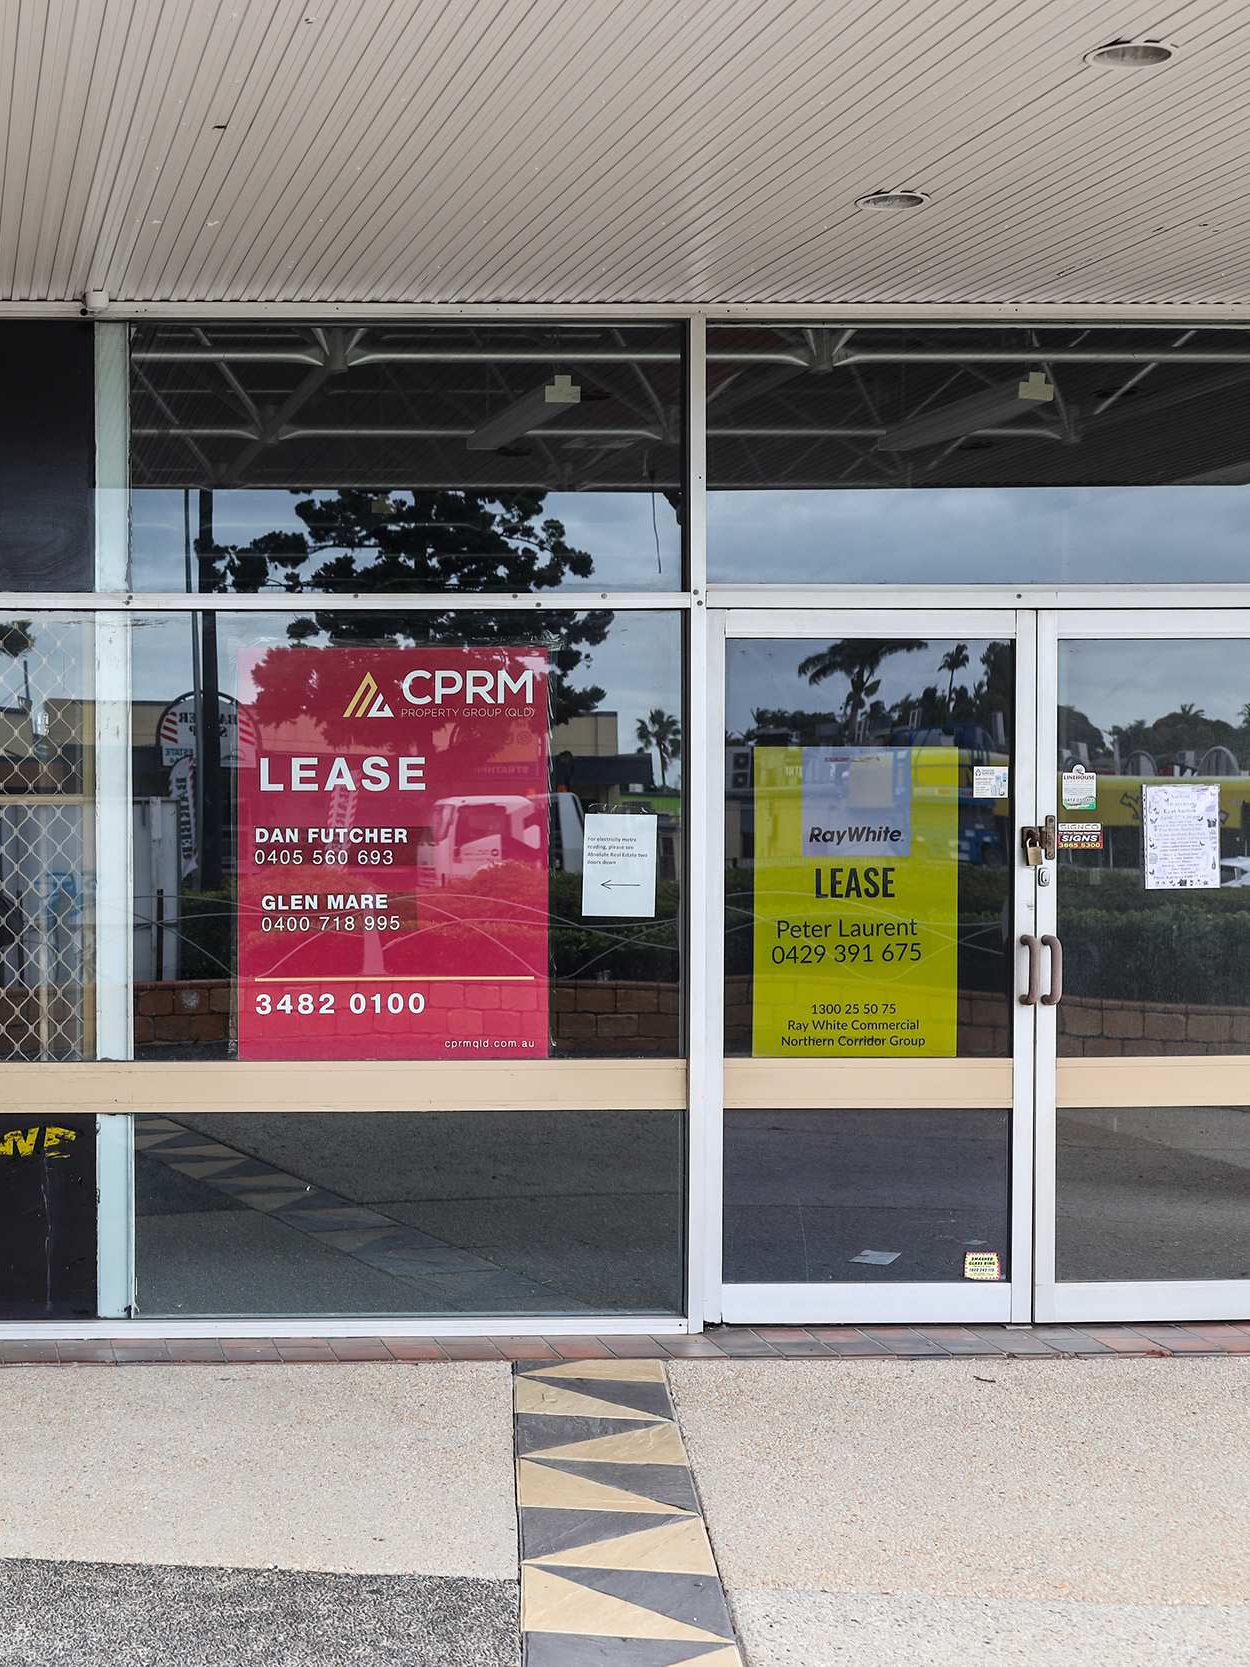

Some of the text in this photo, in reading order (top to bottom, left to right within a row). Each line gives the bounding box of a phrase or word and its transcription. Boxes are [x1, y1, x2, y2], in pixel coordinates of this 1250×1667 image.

[401, 669, 534, 705] CPRM
[401, 707, 535, 718] PROPERTY GROUP (QLD)
[260, 756, 426, 792] LEASE
[255, 827, 408, 844] DAN FUTCHER
[1061, 834, 1098, 842] SIGNS
[255, 849, 394, 866] 0405 560 693
[815, 867, 896, 899] LEASE
[261, 893, 389, 911] GLEN MARE
[261, 916, 401, 933] 0400 718 995
[777, 918, 918, 939] Peter Laurent
[771, 942, 922, 965] 0429 391 675
[255, 992, 426, 1016] 3482 0100
[811, 1003, 897, 1015] 1300 25 50 75
[787, 1019, 920, 1032] Ray White Commercial
[444, 1038, 536, 1050] cprmqld.com.au
[781, 1035, 926, 1048] Northern Corridor Group
